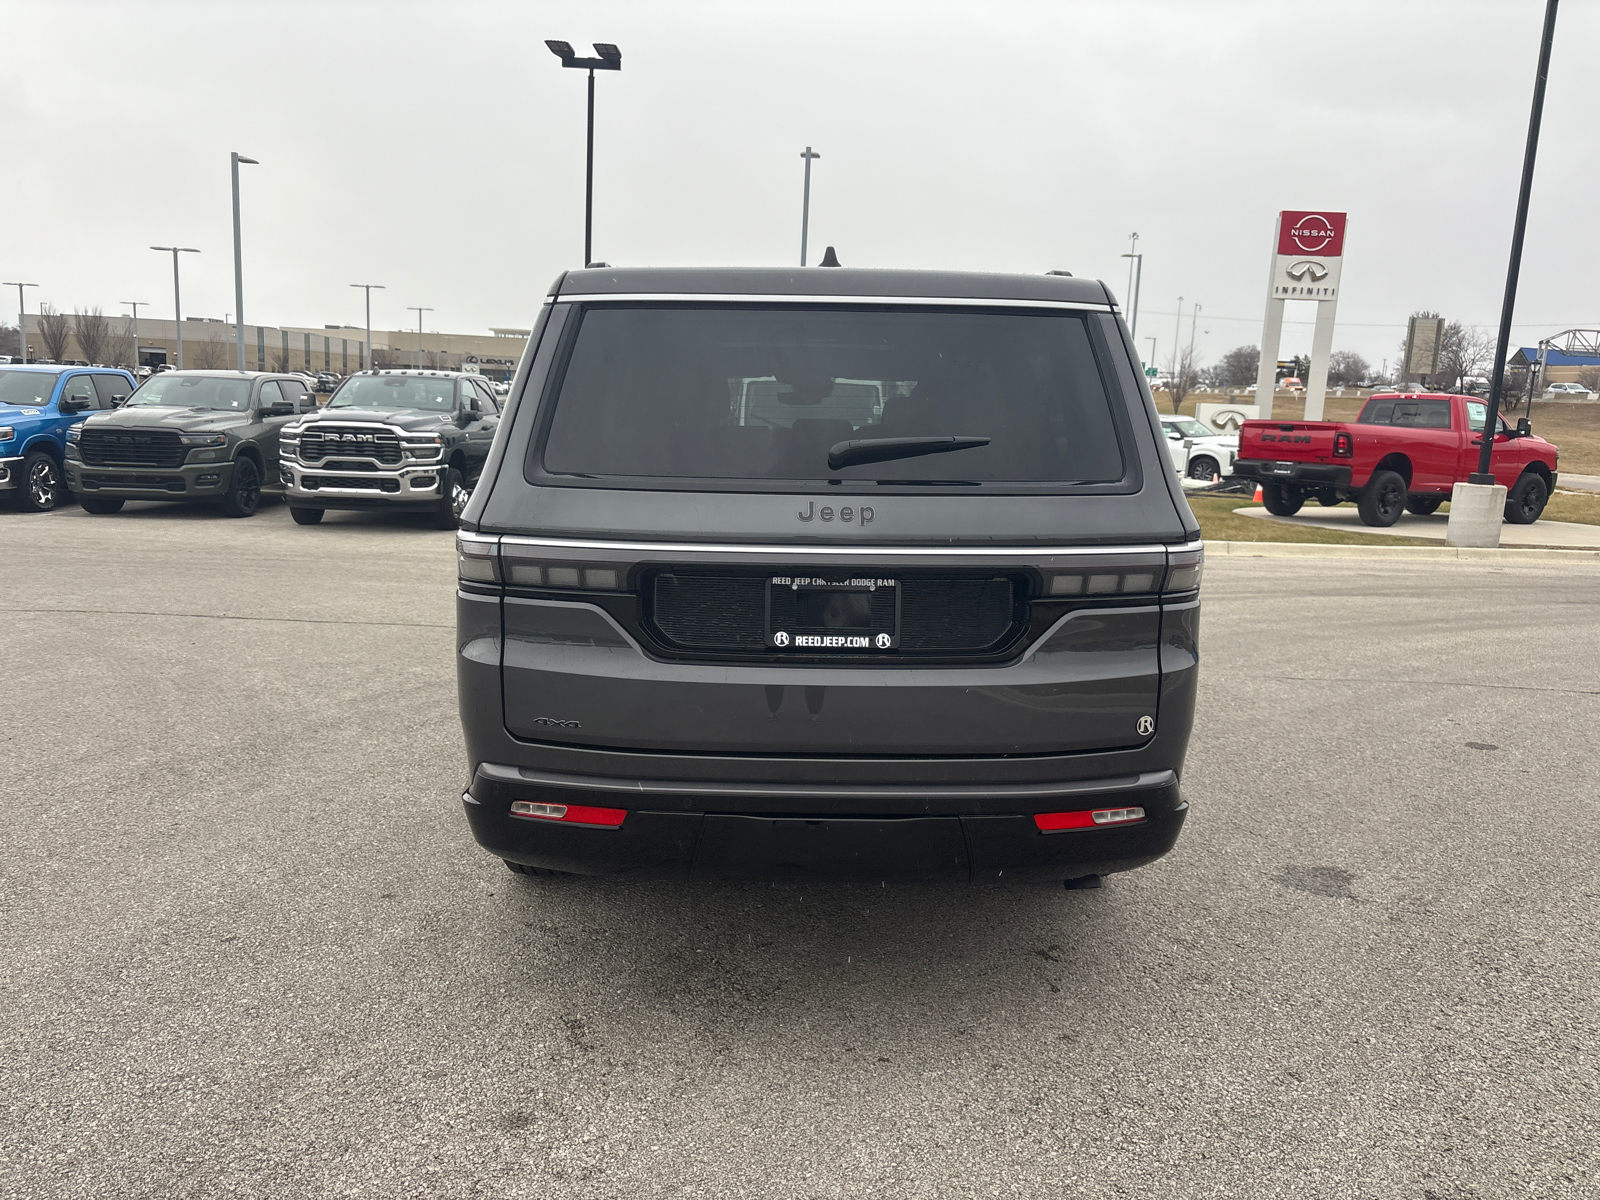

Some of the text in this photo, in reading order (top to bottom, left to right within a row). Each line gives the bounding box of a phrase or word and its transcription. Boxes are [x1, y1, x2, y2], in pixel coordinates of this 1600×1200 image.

[1291, 229, 1335, 237] NISSAN
[1275, 286, 1335, 296] INFINITI
[324, 433, 373, 442] RAM
[1261, 434, 1312, 444] RAM
[797, 501, 876, 526] Jeep
[772, 576, 895, 587] REED JEEP CHRR DODGE RAM
[795, 636, 869, 648] REEDJEEP.COM
